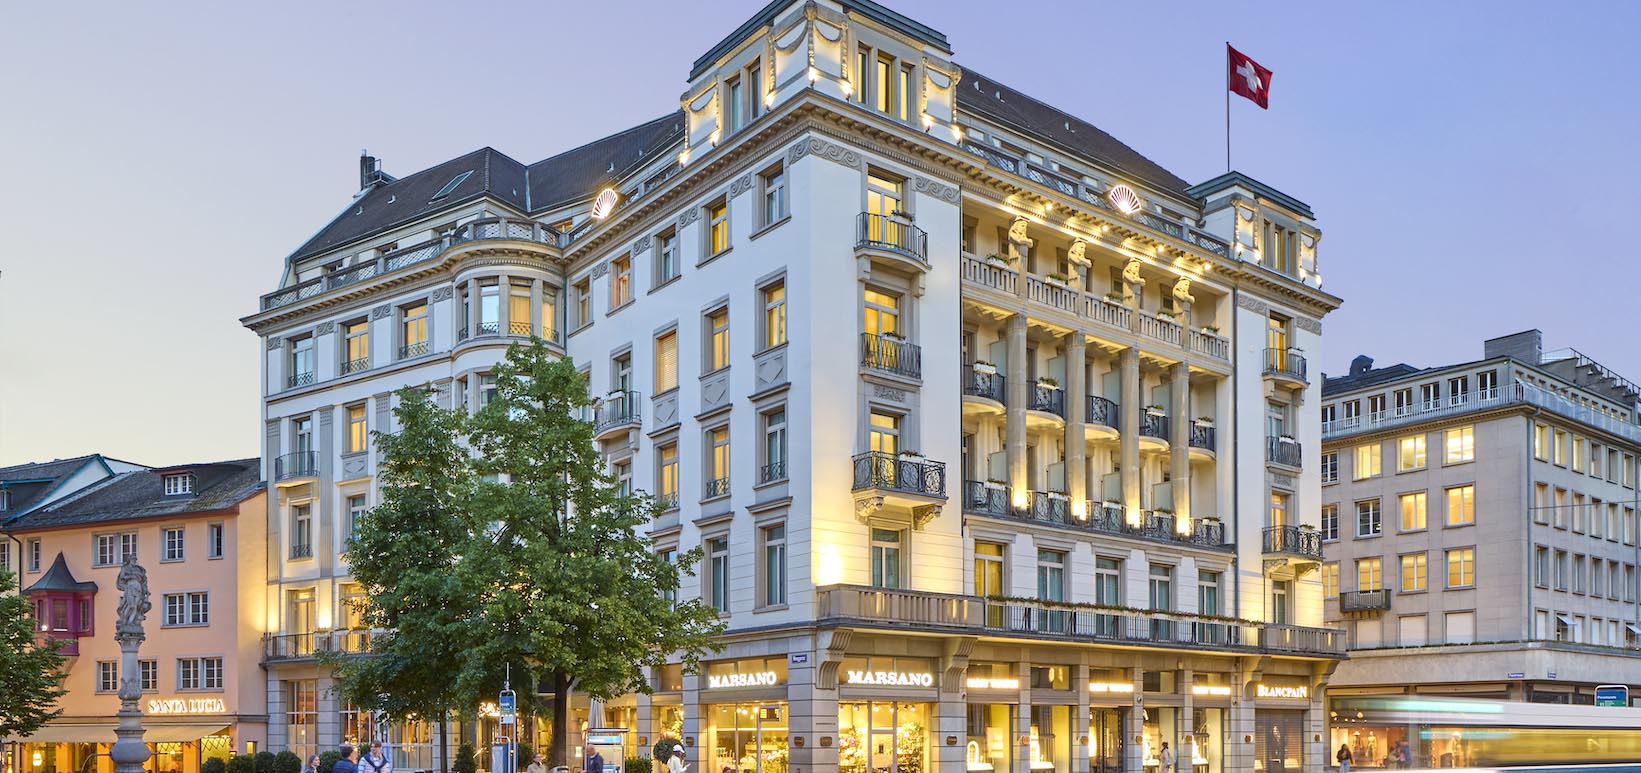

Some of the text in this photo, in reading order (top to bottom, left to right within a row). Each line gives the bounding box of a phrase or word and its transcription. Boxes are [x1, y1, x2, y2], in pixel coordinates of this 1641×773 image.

[709, 671, 777, 688] MARSANO
[847, 671, 934, 687] MARSANO
[148, 698, 226, 713] SANTA LUCIA
